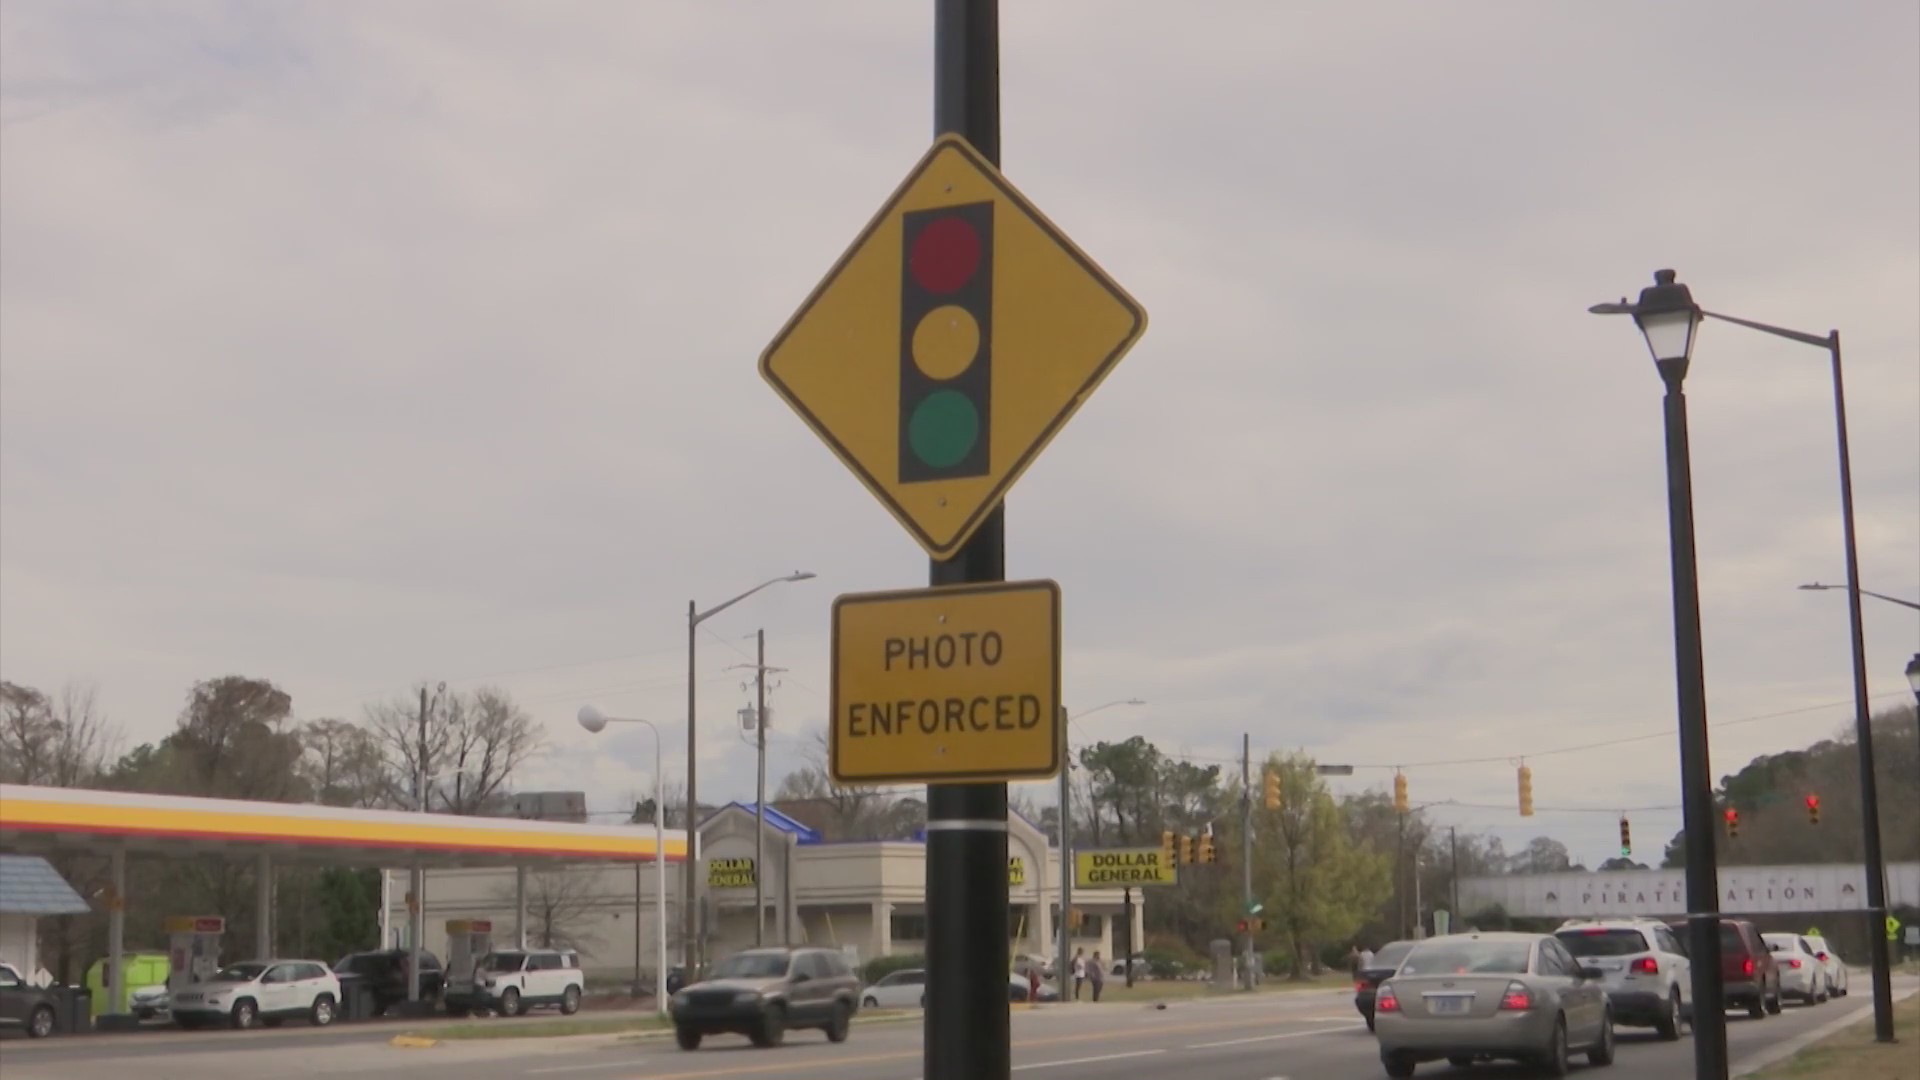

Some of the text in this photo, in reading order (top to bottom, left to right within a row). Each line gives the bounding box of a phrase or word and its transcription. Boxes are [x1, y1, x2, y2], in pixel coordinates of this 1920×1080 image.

[884, 631, 1003, 671] PHOTO
[849, 694, 1041, 737] ENFORCED
[709, 858, 755, 873] DOLLAR
[1092, 853, 1159, 867] DOLLAR
[707, 872, 756, 888] GENERAL
[1087, 867, 1163, 883] GENERAL
[1582, 886, 1816, 905] PIRATE ATION
